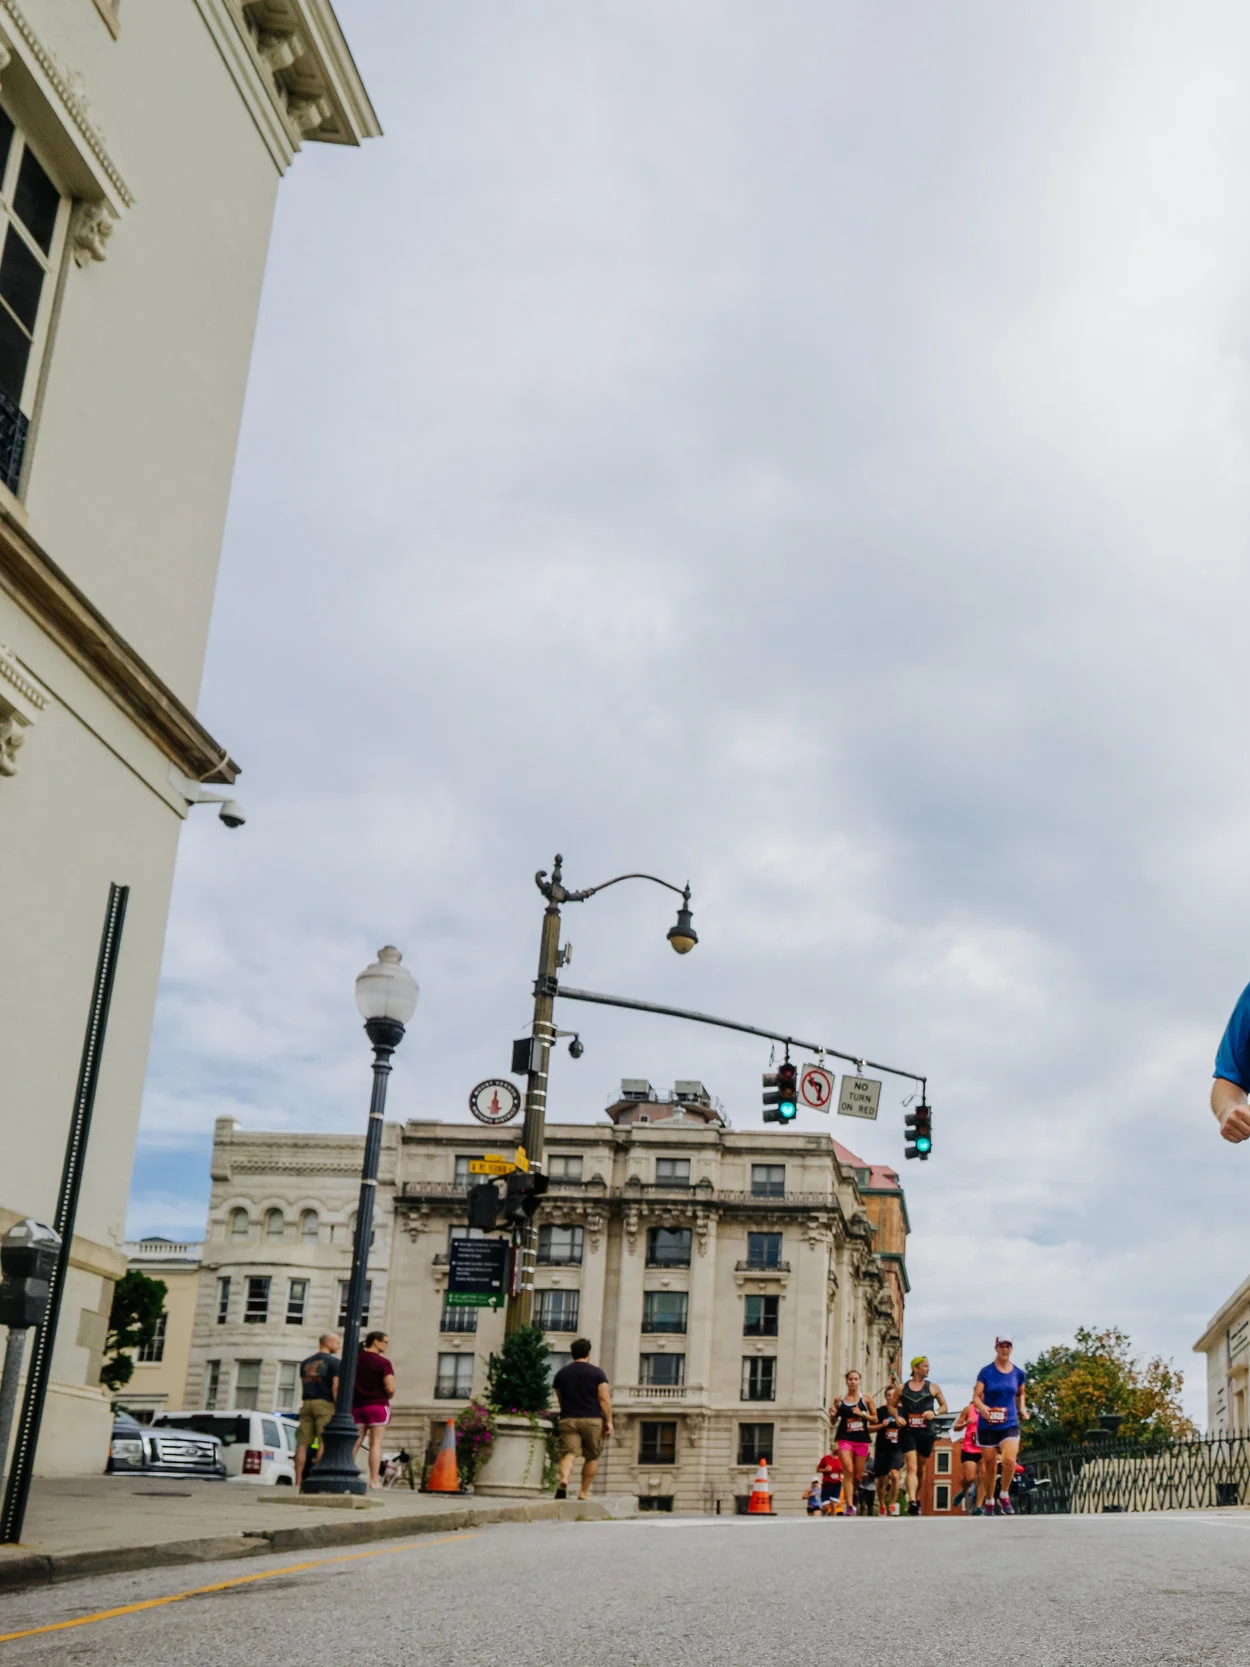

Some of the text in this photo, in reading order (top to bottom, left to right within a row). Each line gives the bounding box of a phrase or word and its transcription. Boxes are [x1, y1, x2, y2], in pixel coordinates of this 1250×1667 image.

[854, 1081, 868, 1091] NO
[849, 1091, 872, 1103] TURN
[841, 1102, 875, 1115] ON RED
